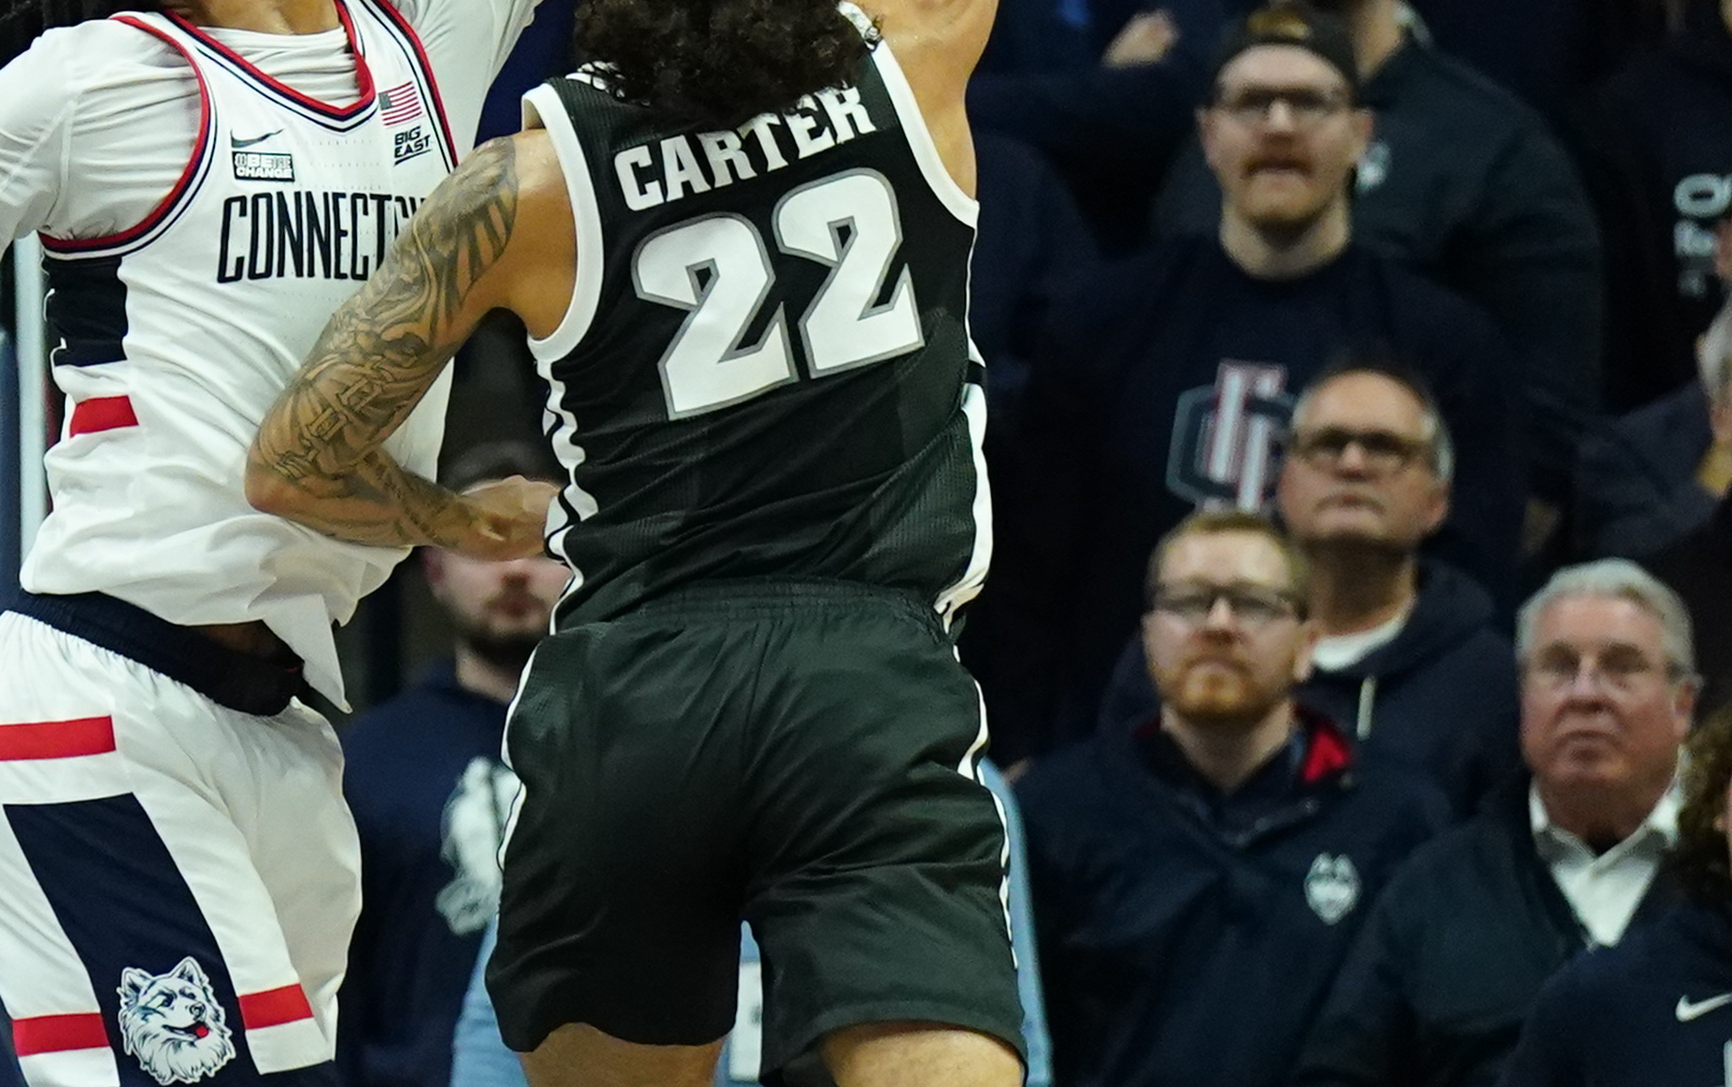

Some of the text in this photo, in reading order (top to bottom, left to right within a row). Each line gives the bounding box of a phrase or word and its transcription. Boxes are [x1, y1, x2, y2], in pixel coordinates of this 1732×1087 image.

[393, 133, 431, 159] EAST
[394, 124, 422, 146] BIG
[614, 83, 876, 211] CARTER
[235, 167, 293, 179] CHANGE
[217, 190, 426, 284] CONNECT
[629, 166, 926, 421] 22
